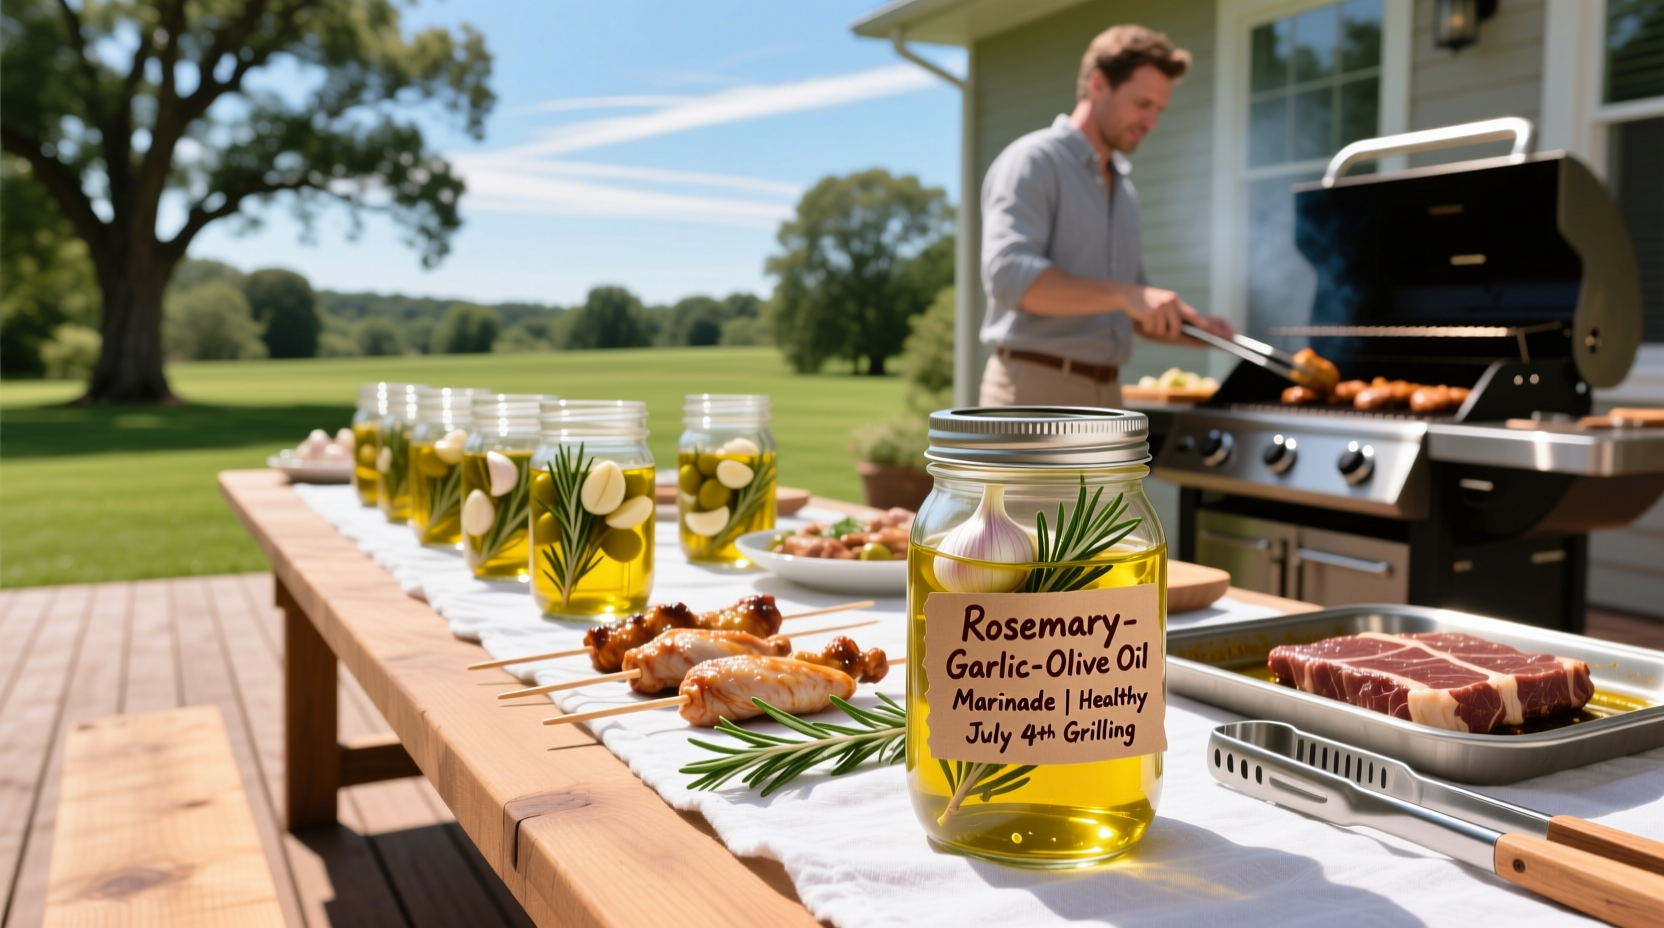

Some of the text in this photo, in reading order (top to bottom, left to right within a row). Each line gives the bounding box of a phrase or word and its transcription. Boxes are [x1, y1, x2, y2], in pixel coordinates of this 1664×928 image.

[962, 604, 1138, 649] Rosemary-
[946, 642, 1148, 680] Garlic-Olive Oil
[952, 688, 1055, 711] Marinade
[1079, 686, 1148, 713] Healthy
[966, 719, 1135, 753] July 4th Grilling
